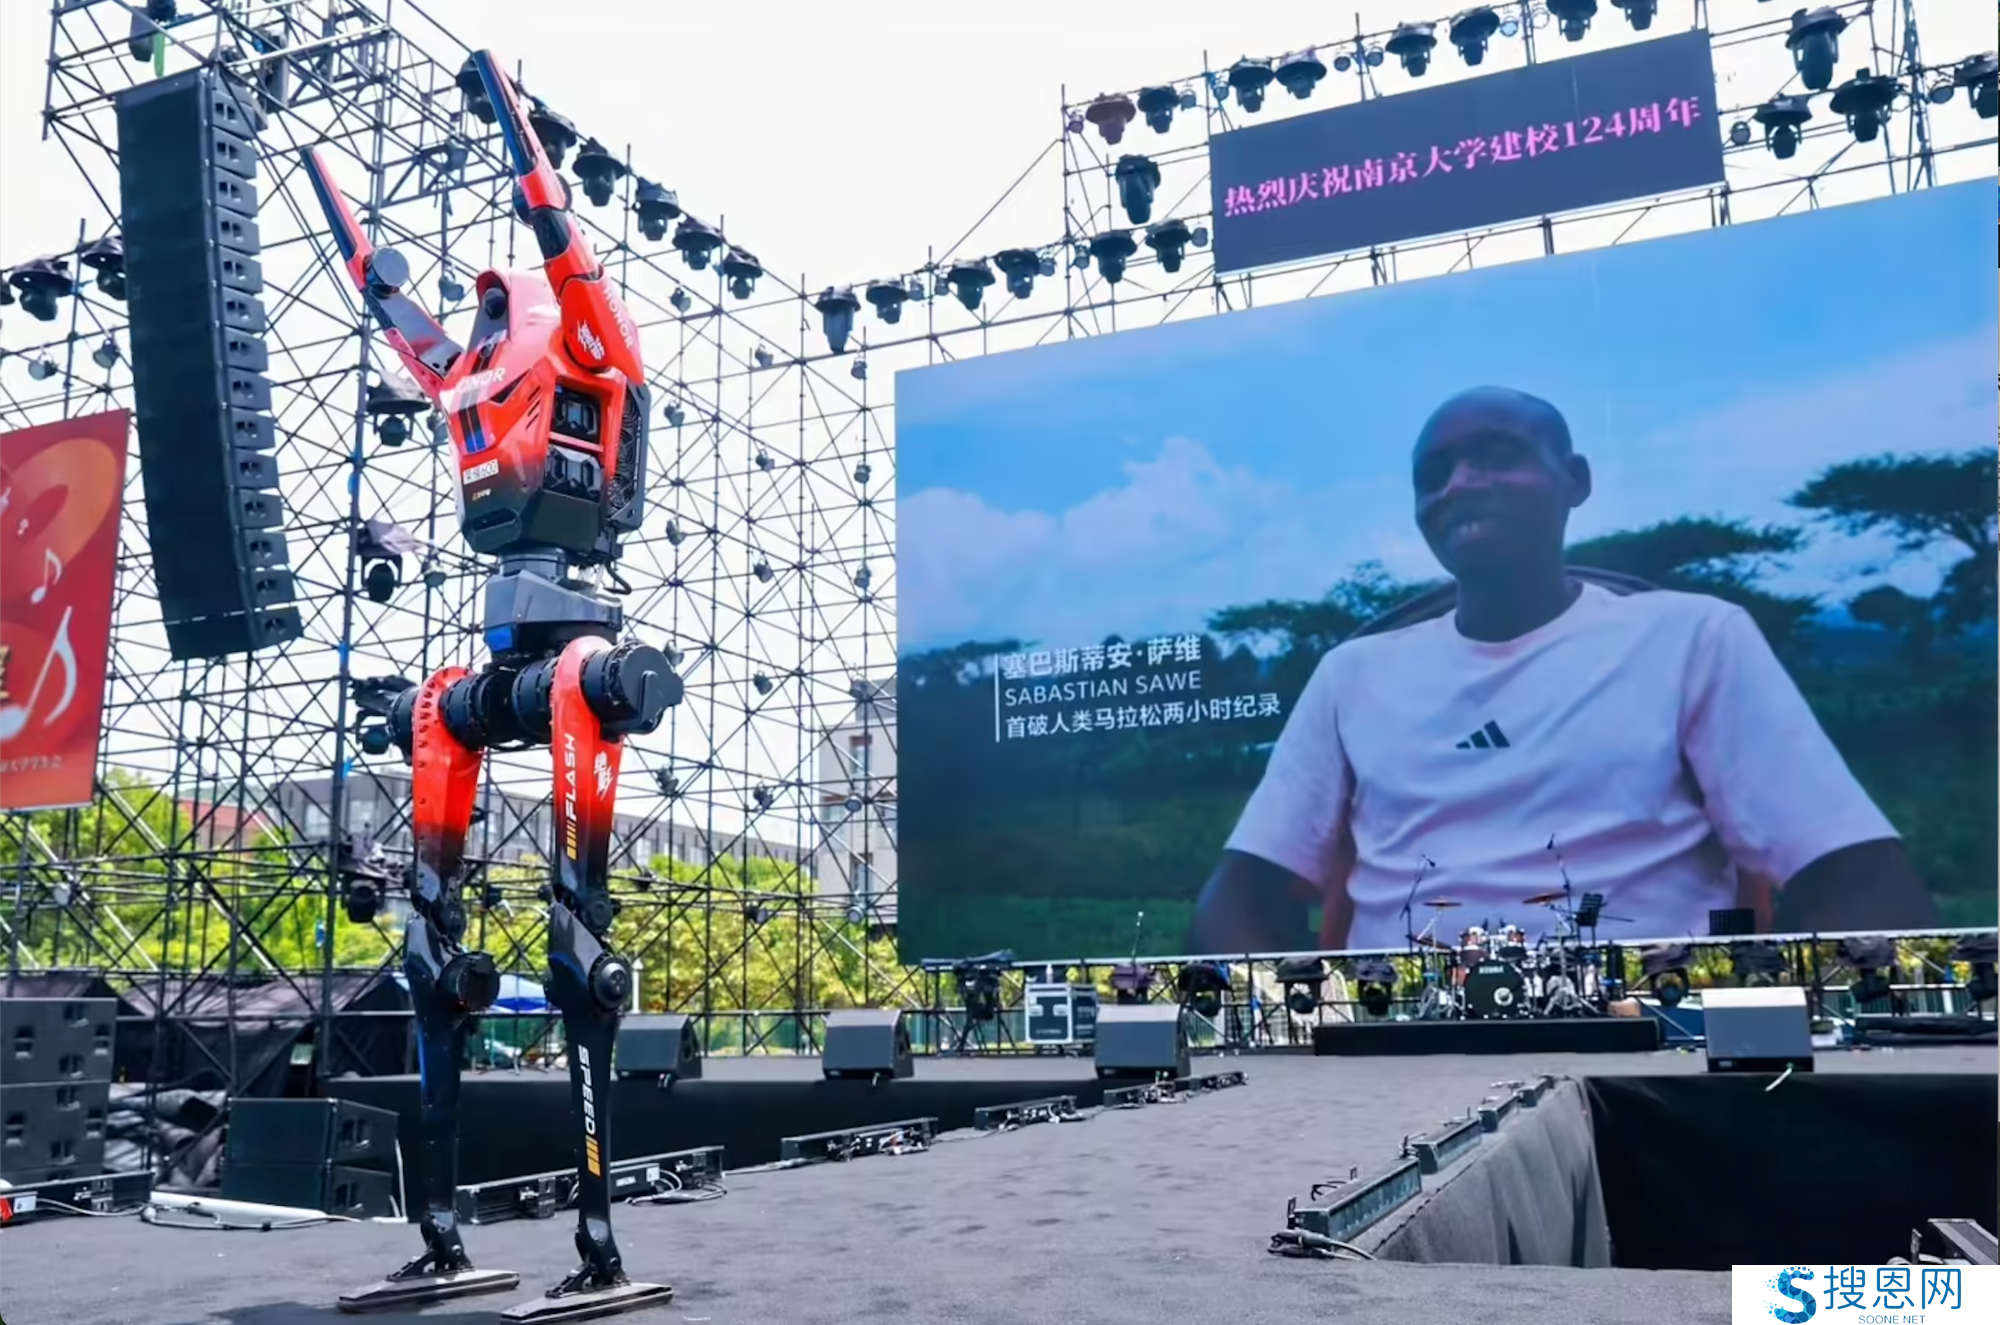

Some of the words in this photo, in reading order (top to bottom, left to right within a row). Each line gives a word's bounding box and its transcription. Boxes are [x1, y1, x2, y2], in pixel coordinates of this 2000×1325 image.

[1223, 96, 1702, 217] 热烈庆祝南京大学建校124周年
[1003, 634, 1201, 680] 塞巴斯蒂安·萨维
[1005, 678, 1128, 707] SABASTIAN
[1135, 670, 1202, 694] SAWE
[1005, 692, 1281, 739] 首破人类马拉松两小时纪录
[564, 733, 577, 821] FLASH
[578, 1044, 596, 1135] SPEED
